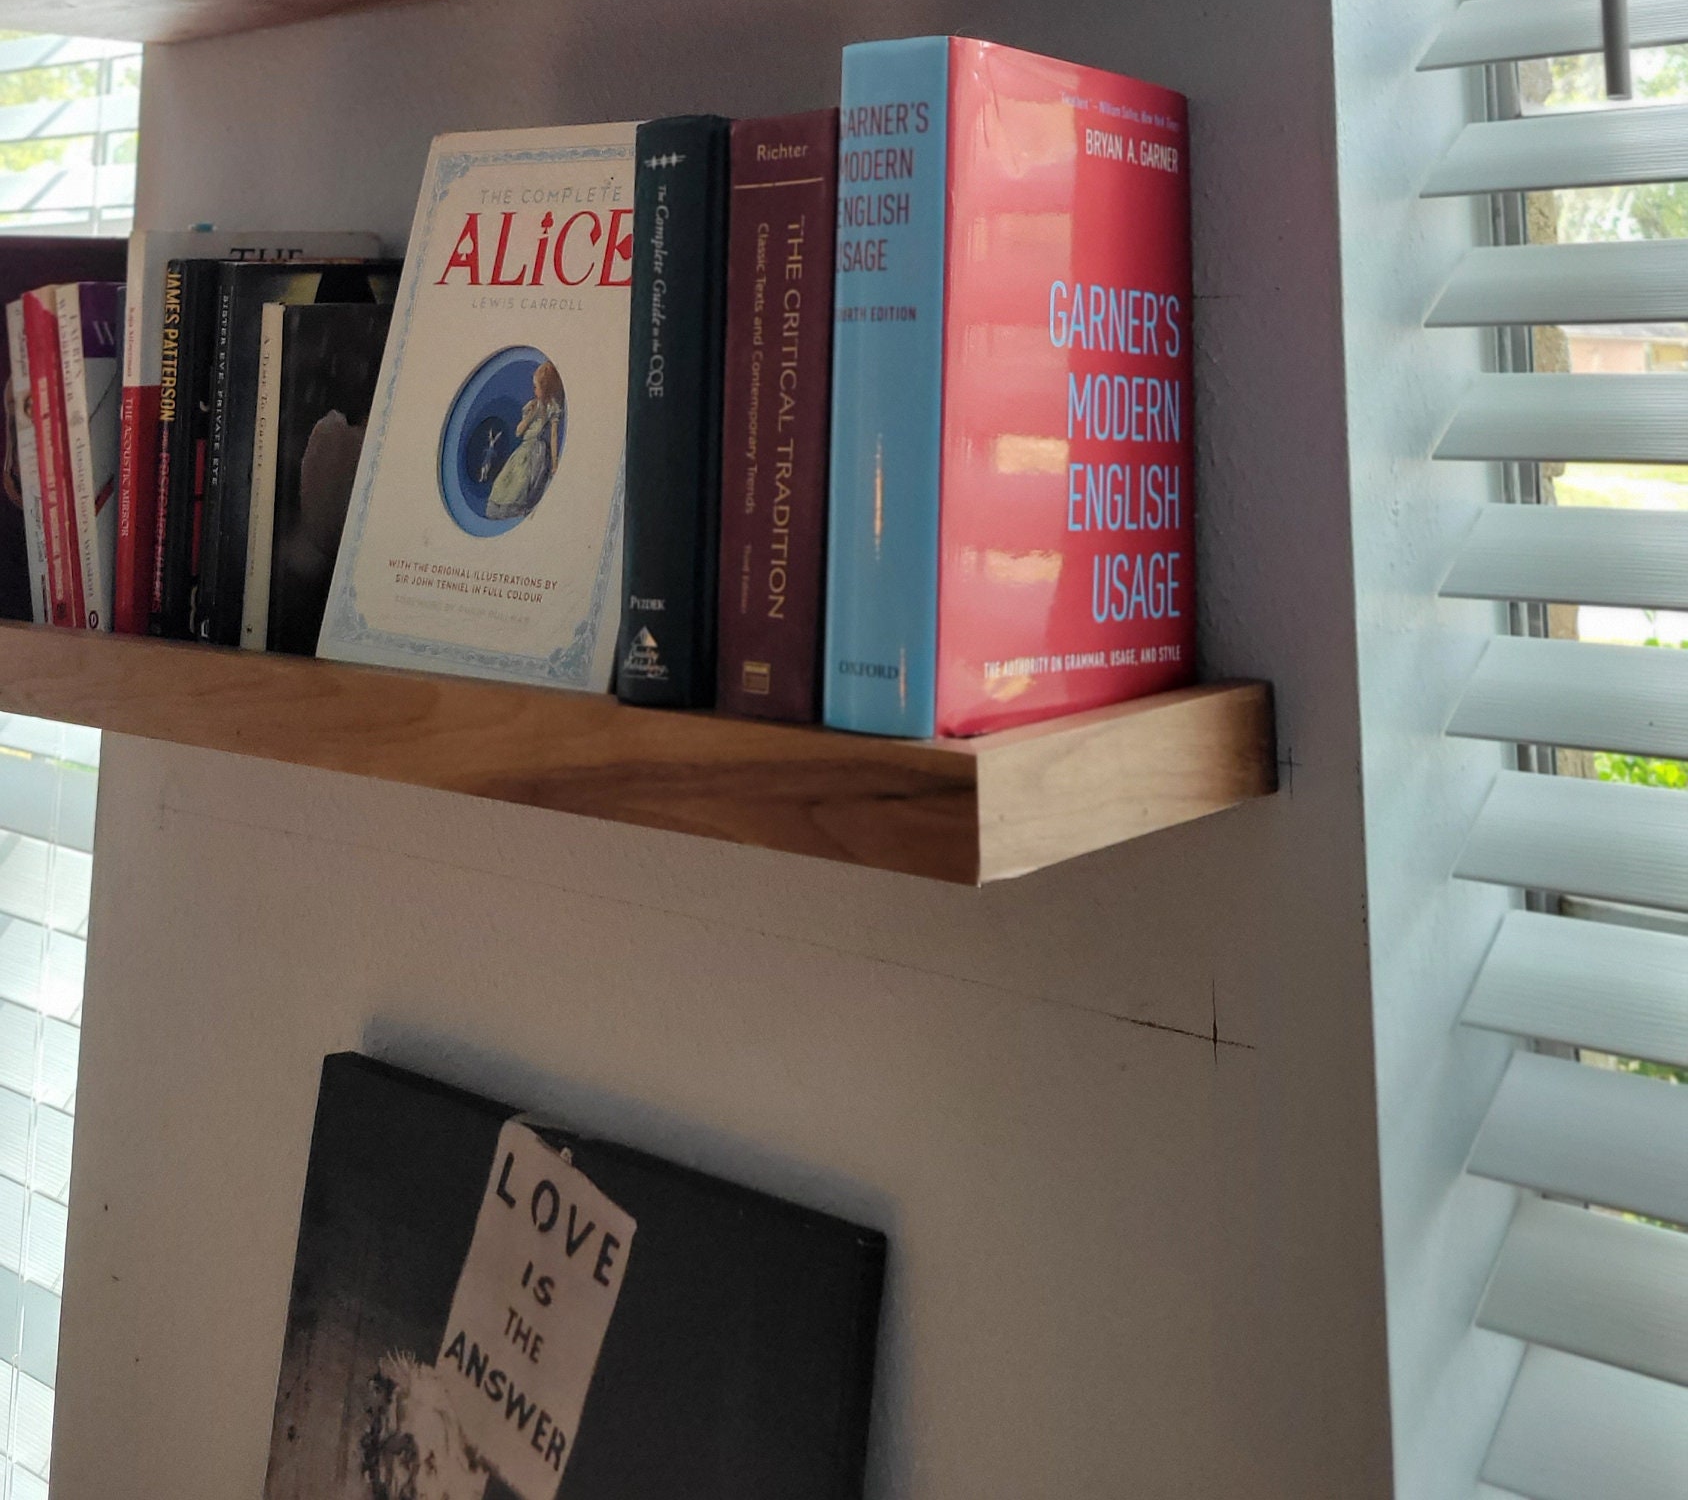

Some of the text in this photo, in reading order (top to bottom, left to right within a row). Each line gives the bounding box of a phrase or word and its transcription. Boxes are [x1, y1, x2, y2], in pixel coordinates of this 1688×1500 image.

[756, 143, 808, 162] Richter
[841, 102, 930, 140] ARNER'S
[1085, 127, 1179, 174] BRYAN A. GARNER
[480, 185, 623, 205] THE COMPLETE
[471, 297, 585, 312] LEWIS CARROLL
[646, 184, 669, 398] The Complete Guide CQE
[869, 305, 917, 323] EDITION
[1049, 279, 1180, 358] GARNER'S
[160, 270, 182, 421] JAMES PATTERSON
[745, 222, 769, 515] Classic Texts and Contemporary Trends
[210, 294, 230, 487] SISTER EVE, PRIVATE EYE
[767, 214, 806, 620] THE CRITICAL TRADITION
[1067, 372, 1180, 444] MODERN
[75, 436, 88, 493] chasing
[121, 397, 134, 538] THE ACOUSTIC MIRROR
[1067, 462, 1180, 532] ENGLISH
[388, 558, 558, 591] WITH THE ORIGINAL ILLUSTRATIONS BY
[395, 573, 543, 604] SIR JOHN TENNIEL IN FULL COLOUR
[1092, 551, 1180, 624] USAGE
[984, 644, 1181, 679] THE AUTHORITY ON GRAMMAR, USAGE, AND STYLE
[495, 1152, 621, 1288] LOVE
[521, 1261, 555, 1307] IS
[503, 1306, 545, 1364] THE
[444, 1329, 567, 1472] ANSWER
